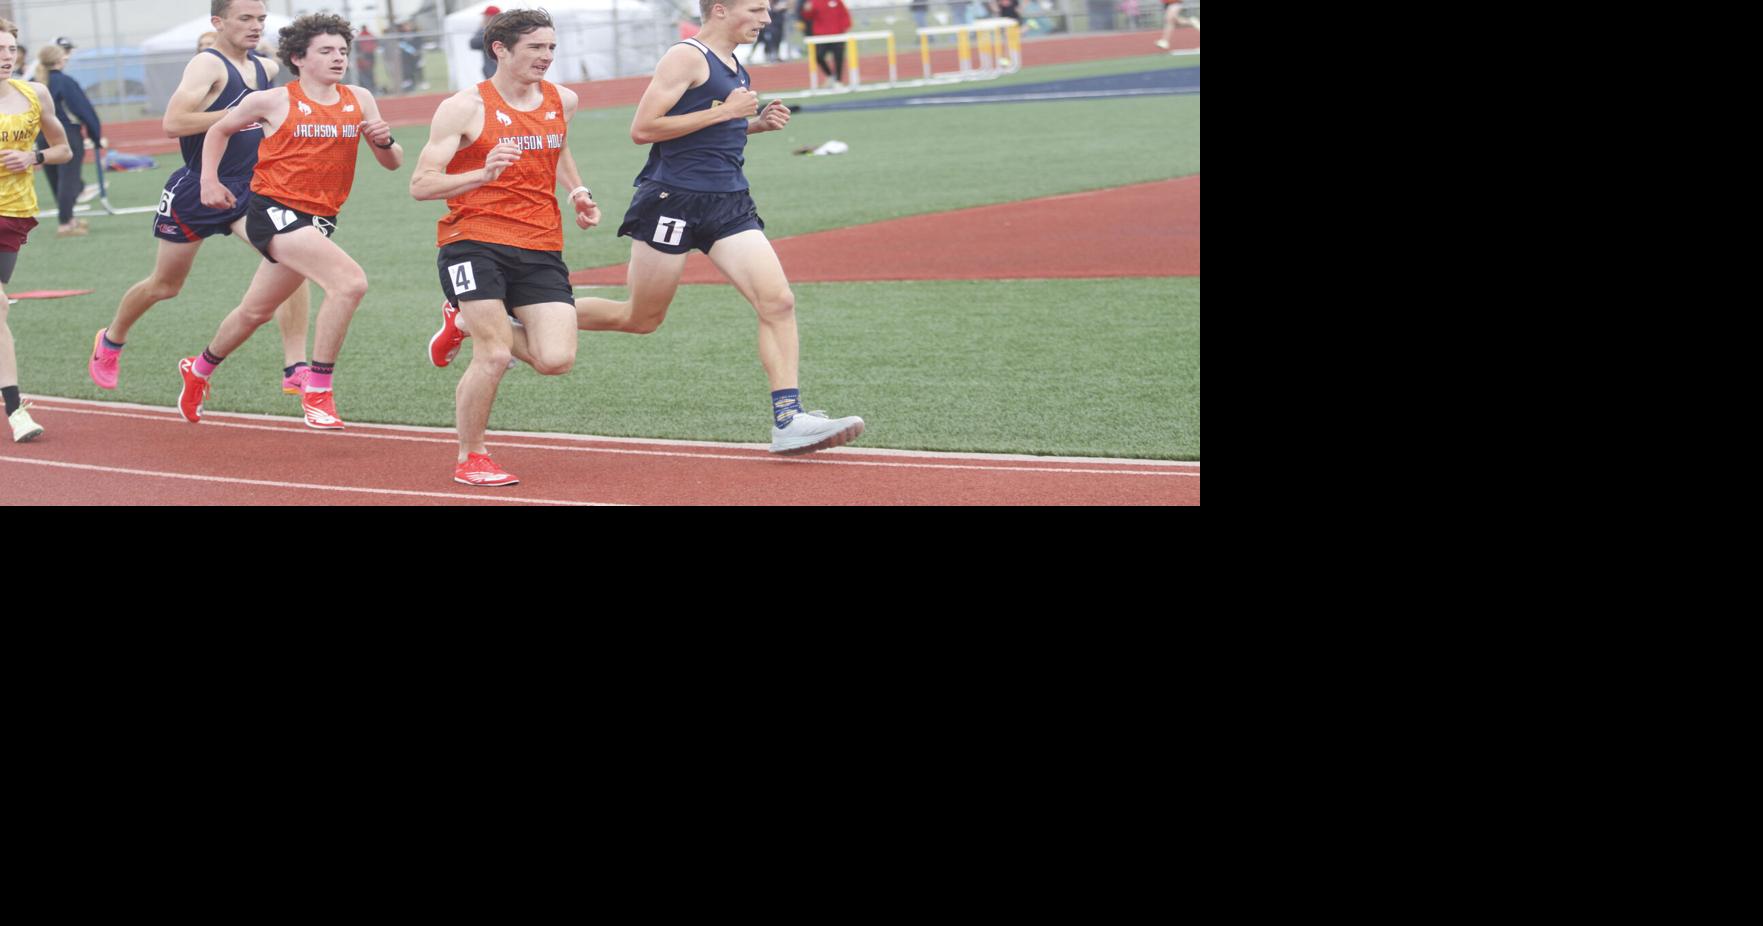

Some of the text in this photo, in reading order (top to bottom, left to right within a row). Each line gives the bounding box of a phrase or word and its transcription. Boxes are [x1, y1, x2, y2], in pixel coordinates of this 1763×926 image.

[293, 124, 338, 138] JACKSON
[159, 192, 169, 213] 6
[271, 206, 287, 226] 7
[662, 220, 677, 243] 1
[455, 264, 471, 290] 4
